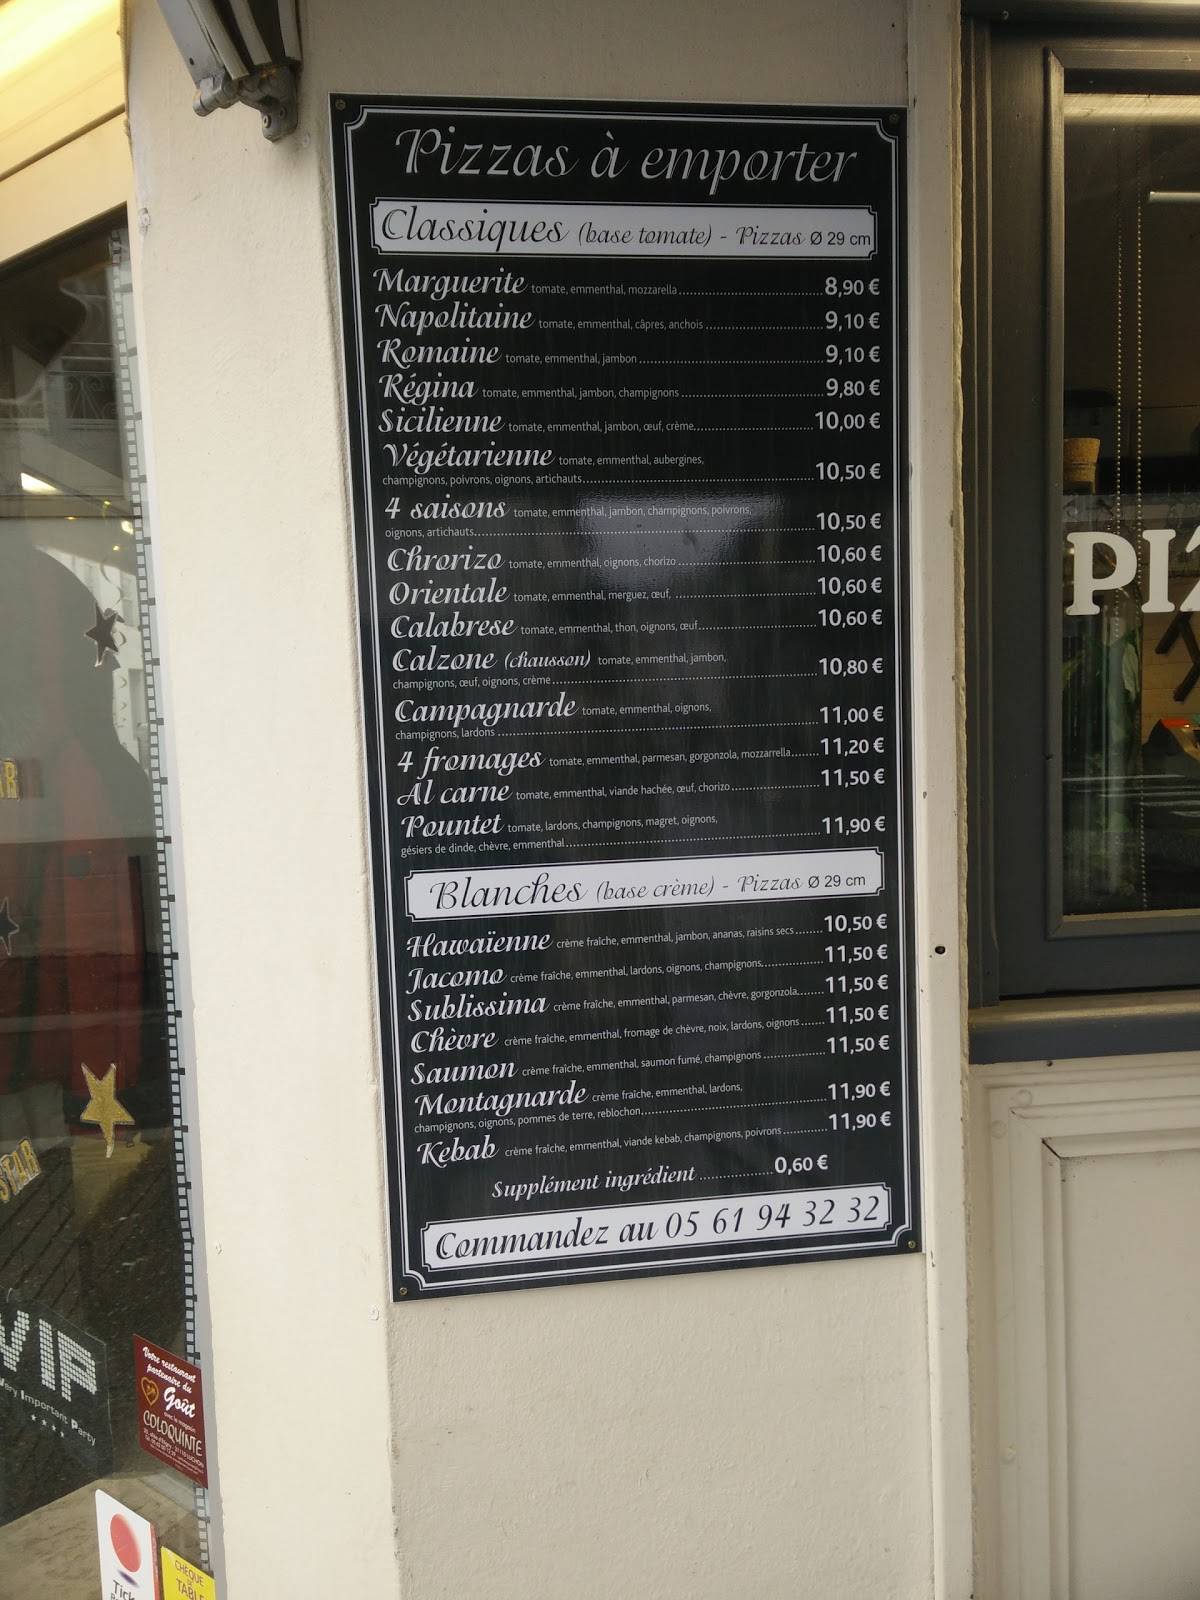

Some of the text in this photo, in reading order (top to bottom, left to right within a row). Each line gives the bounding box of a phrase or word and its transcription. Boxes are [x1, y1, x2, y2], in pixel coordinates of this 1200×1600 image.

[396, 126, 856, 195] Pizzas à emporter
[382, 205, 570, 252] Classiques
[578, 222, 633, 245] (base
[639, 224, 711, 247] tomate)
[736, 225, 805, 245] Pizzas
[827, 231, 844, 245] 29
[850, 235, 870, 245] cm
[373, 267, 526, 300] Marguerite
[531, 284, 568, 294] tomate,
[570, 284, 625, 295] emmenthal,
[628, 284, 676, 294] mozzarella
[375, 301, 533, 335] Napolitaine
[538, 320, 575, 329] tomate,
[577, 318, 632, 329] emmenthal,
[635, 319, 666, 331] câpres,
[669, 318, 703, 329] anchois
[377, 337, 500, 368] Romaine
[505, 354, 542, 364] tomate,
[544, 353, 599, 364] emmenthal,
[602, 353, 636, 366] jambon
[379, 372, 476, 405] Régina
[378, 406, 504, 432] Sicilienne
[384, 441, 703, 474] Végétarienne tomate, emmenthal, aubergines,
[382, 473, 447, 487] champignons,
[450, 474, 492, 486] poivrons,
[494, 474, 533, 486] oignons,
[535, 473, 581, 483] artichauts
[385, 494, 507, 518] 4 saisons
[387, 545, 504, 571] Chrorizo
[1065, 529, 1200, 615] PI
[389, 577, 510, 604] Orientale
[391, 611, 516, 638] Calabrese
[392, 645, 590, 671] Calzone (chausson)
[395, 691, 577, 727] Campagnarde
[398, 746, 544, 778] 4 fromages
[397, 779, 434, 805] Al
[440, 786, 512, 803] carne
[516, 791, 551, 800] tomate,
[553, 786, 606, 798] emmenthal,
[609, 785, 638, 795] viande
[641, 784, 674, 794] hachée,
[676, 782, 696, 792] œuf,
[698, 782, 729, 791] chorizo
[401, 814, 717, 837] Pountet tomate, lardons, champignons, magret, oignons,
[401, 845, 432, 858] gésiers
[435, 843, 445, 853] de
[448, 842, 476, 852] dinde,
[478, 841, 510, 851] chèvre,
[513, 838, 564, 849] emmenthal
[429, 872, 583, 909] Blanches
[596, 880, 648, 902] (base
[653, 876, 714, 897] crème)
[737, 874, 800, 892] Pizzas
[824, 874, 840, 887] 29
[845, 876, 865, 886] cm
[407, 931, 551, 957] Hawaïenne
[556, 939, 584, 948] crème
[586, 936, 618, 946] fraîche,
[620, 932, 673, 944] emmenthal,
[675, 931, 710, 943] jambon,
[747, 928, 773, 936] raisins
[406, 968, 506, 994] Jacomo
[408, 992, 548, 1021] Sublissima
[411, 1027, 498, 1052] Chèvre
[411, 1062, 518, 1084] Saumon
[415, 1080, 742, 1115] Montagnarde crème fraîche, emmenthal, lardons,
[414, 1121, 476, 1133] champignons,
[478, 1114, 515, 1129] oignons,
[518, 1115, 556, 1126] pommes
[558, 1112, 569, 1121] de
[597, 1107, 640, 1117] reblochon
[417, 1134, 498, 1167] Kebab
[505, 1147, 532, 1156] crème
[535, 1143, 567, 1153] fraîche,
[569, 1138, 621, 1151] emmenthal,
[623, 1136, 652, 1146] viande
[654, 1133, 682, 1143] kebab,
[684, 1131, 742, 1142] champignons,
[745, 1128, 781, 1139] poivrons
[492, 1175, 598, 1200] Supplément
[605, 1165, 694, 1191] ingrédient
[436, 1195, 879, 1259] Commandez au 05 61 94 32 32
[142, 1346, 196, 1383] Votre restaurant
[147, 1364, 192, 1394] partenaire du
[164, 1386, 195, 1418] Goût
[21, 1390, 68, 1424] Important
[71, 1418, 96, 1446] Party
[144, 1410, 202, 1456] COLOQUINTE
